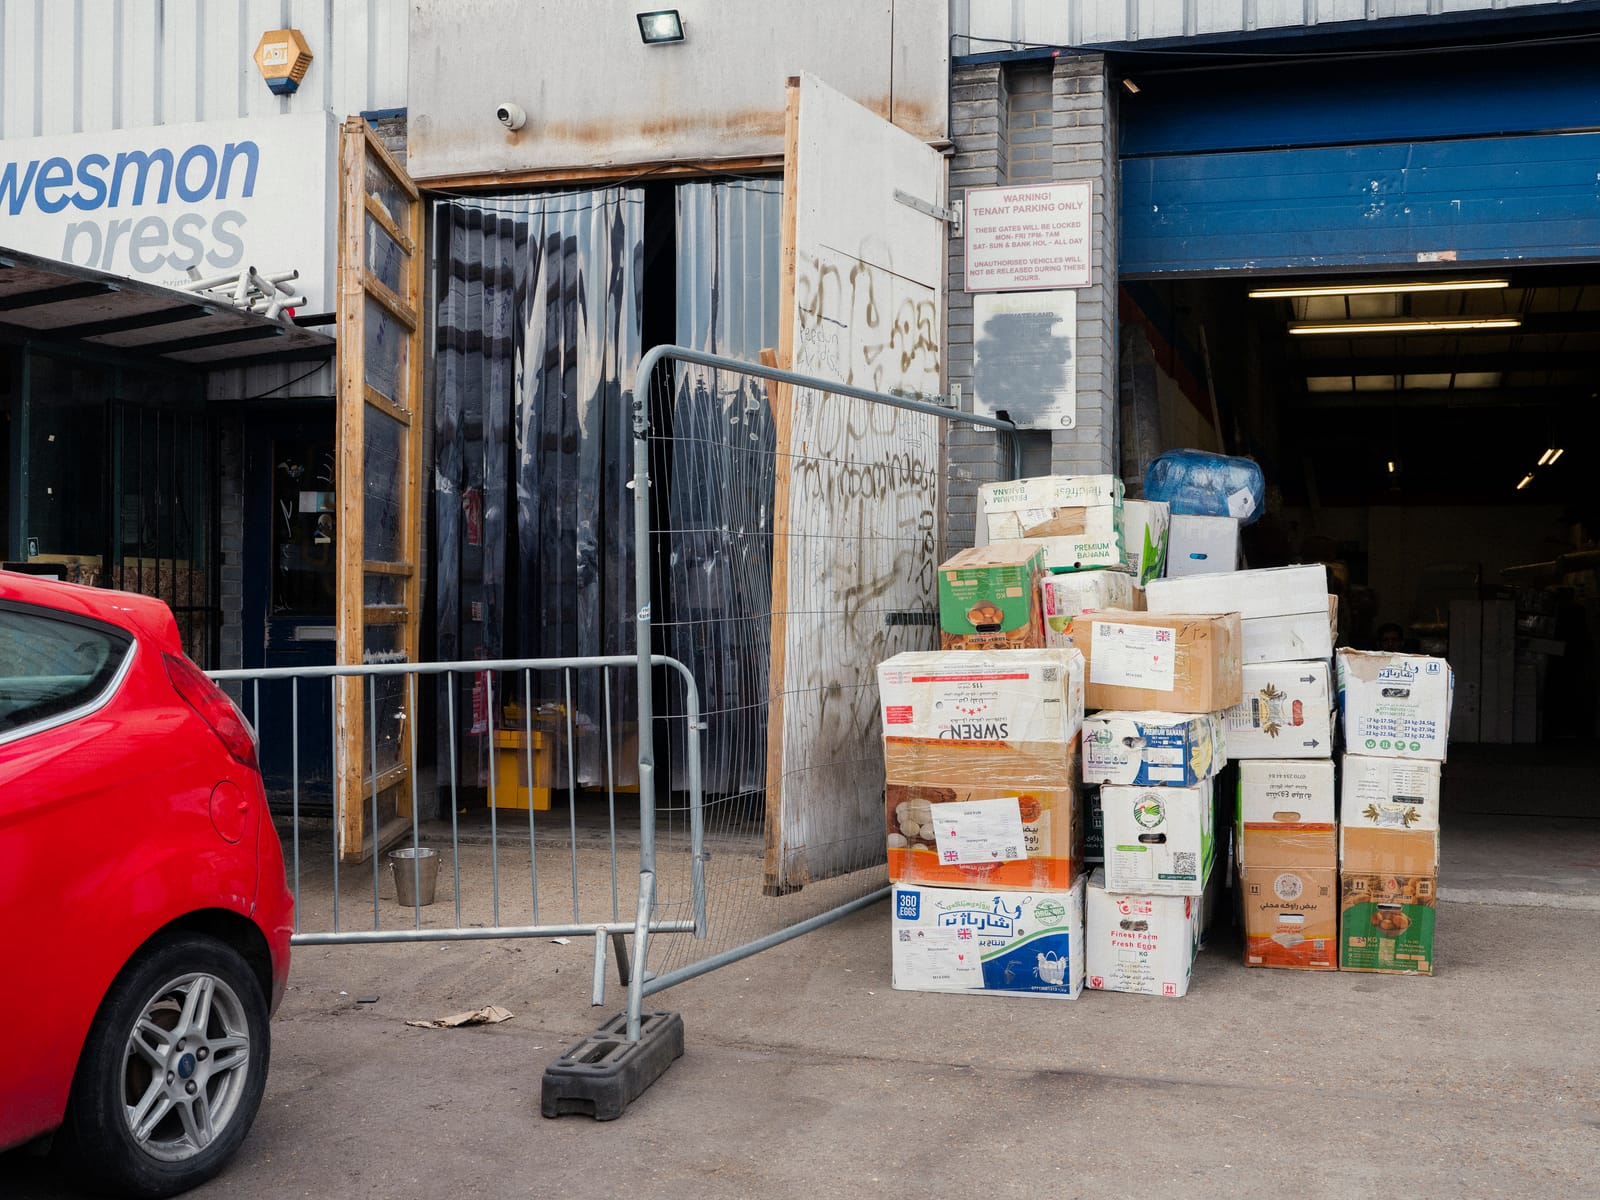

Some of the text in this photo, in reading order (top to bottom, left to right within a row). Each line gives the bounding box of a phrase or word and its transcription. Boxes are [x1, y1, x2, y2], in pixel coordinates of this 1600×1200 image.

[1003, 192, 1051, 203] WARNING!
[973, 202, 1083, 216] TENANT PARKING ONLY
[1052, 221, 1081, 229] LOCKED
[62, 210, 247, 274] press
[1012, 240, 1031, 248] BANK
[1069, 237, 1083, 245] DAY
[974, 259, 1027, 268] UNAUTHORISED
[1029, 257, 1063, 265] VEHICLES
[996, 266, 1033, 274] RELEASED
[1035, 265, 1062, 273] DURING
[1063, 263, 1086, 271] THESE
[992, 487, 1025, 496] BANANA
[993, 494, 1028, 503] PREMIUM
[1074, 542, 1110, 552] PREMIUM
[1076, 549, 1110, 559] BANANA
[950, 723, 1008, 741] SWREN
[900, 895, 917, 907] 360
[900, 907, 917, 917] EGGS
[1110, 930, 1136, 939] Finest
[1112, 940, 1157, 951] Fresh Eggs
